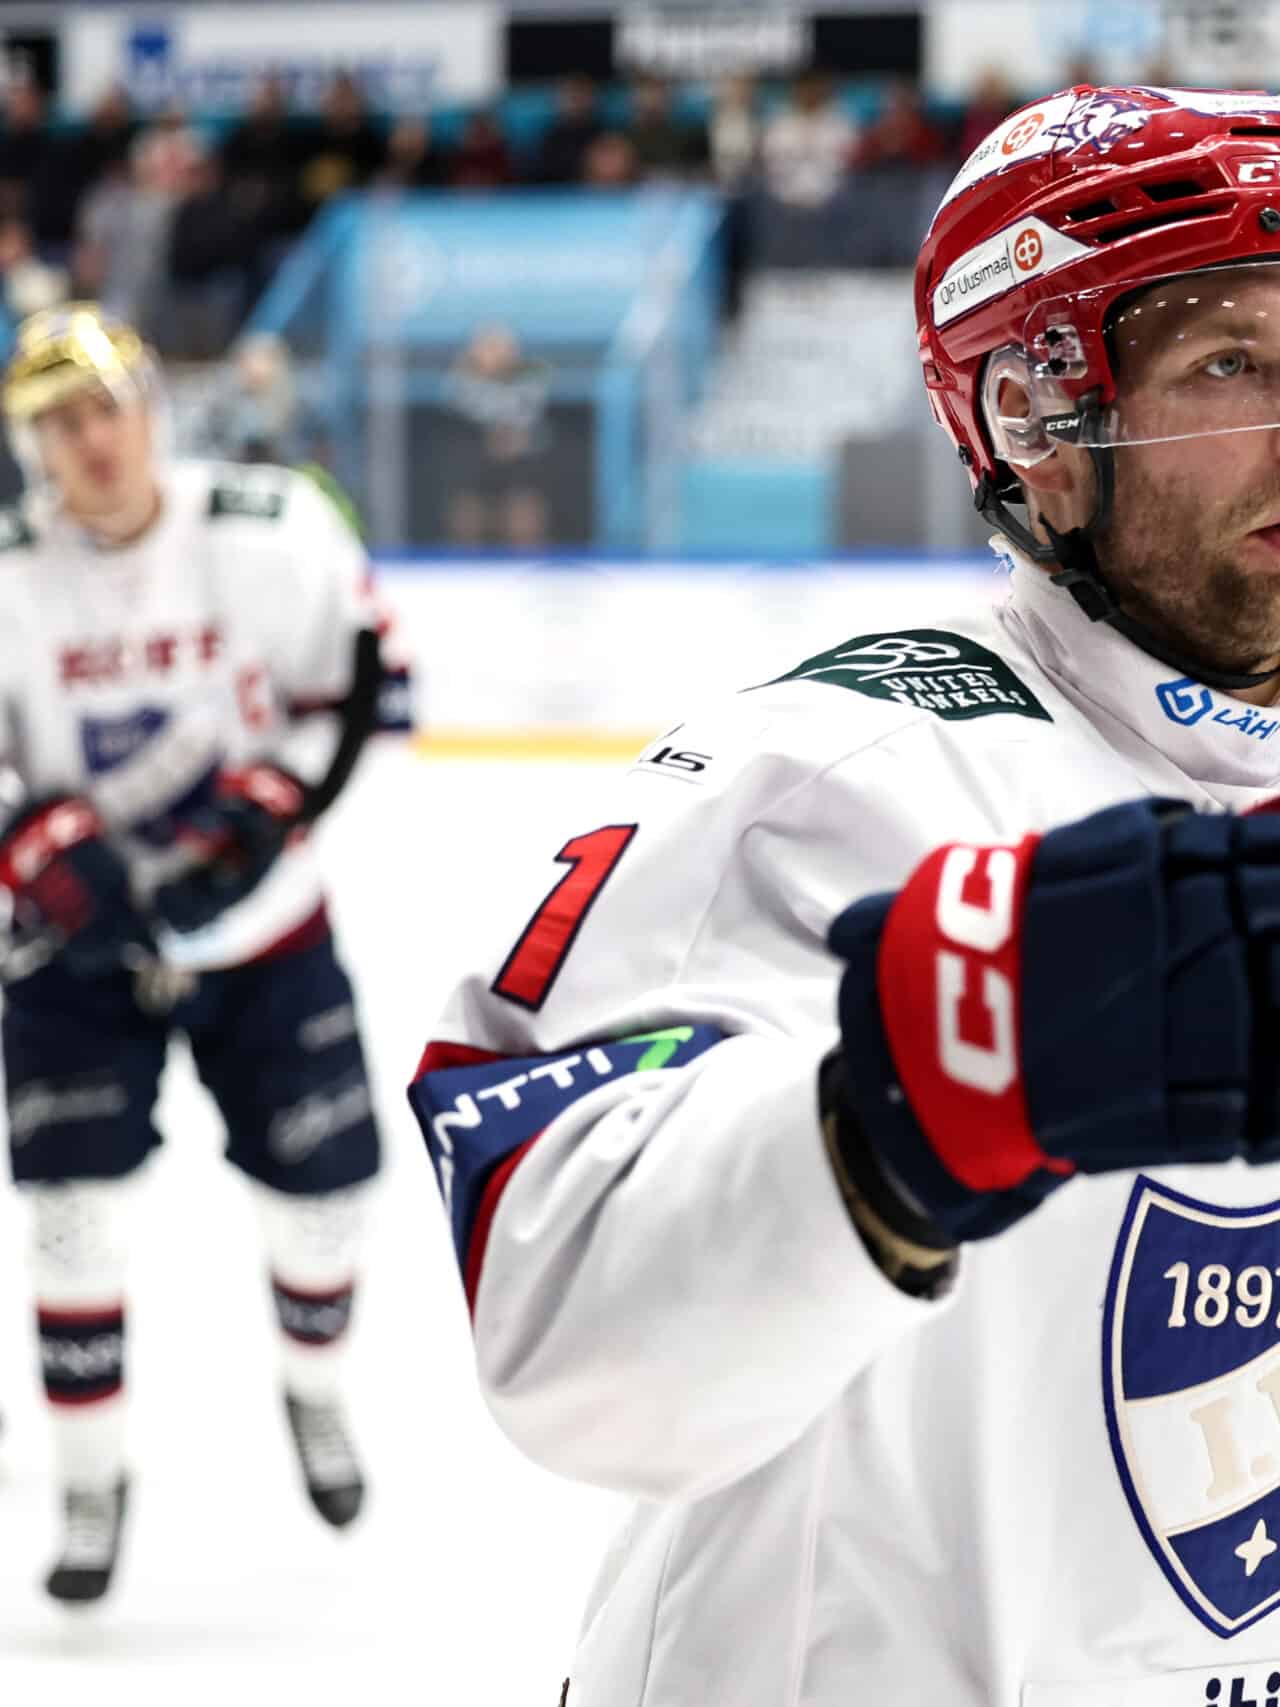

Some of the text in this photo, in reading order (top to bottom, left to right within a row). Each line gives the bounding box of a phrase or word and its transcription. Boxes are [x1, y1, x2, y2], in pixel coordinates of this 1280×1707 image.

[940, 256, 1010, 305] OP Uusimaa
[1045, 418, 1080, 431] CCM
[881, 672, 998, 692] UNITED
